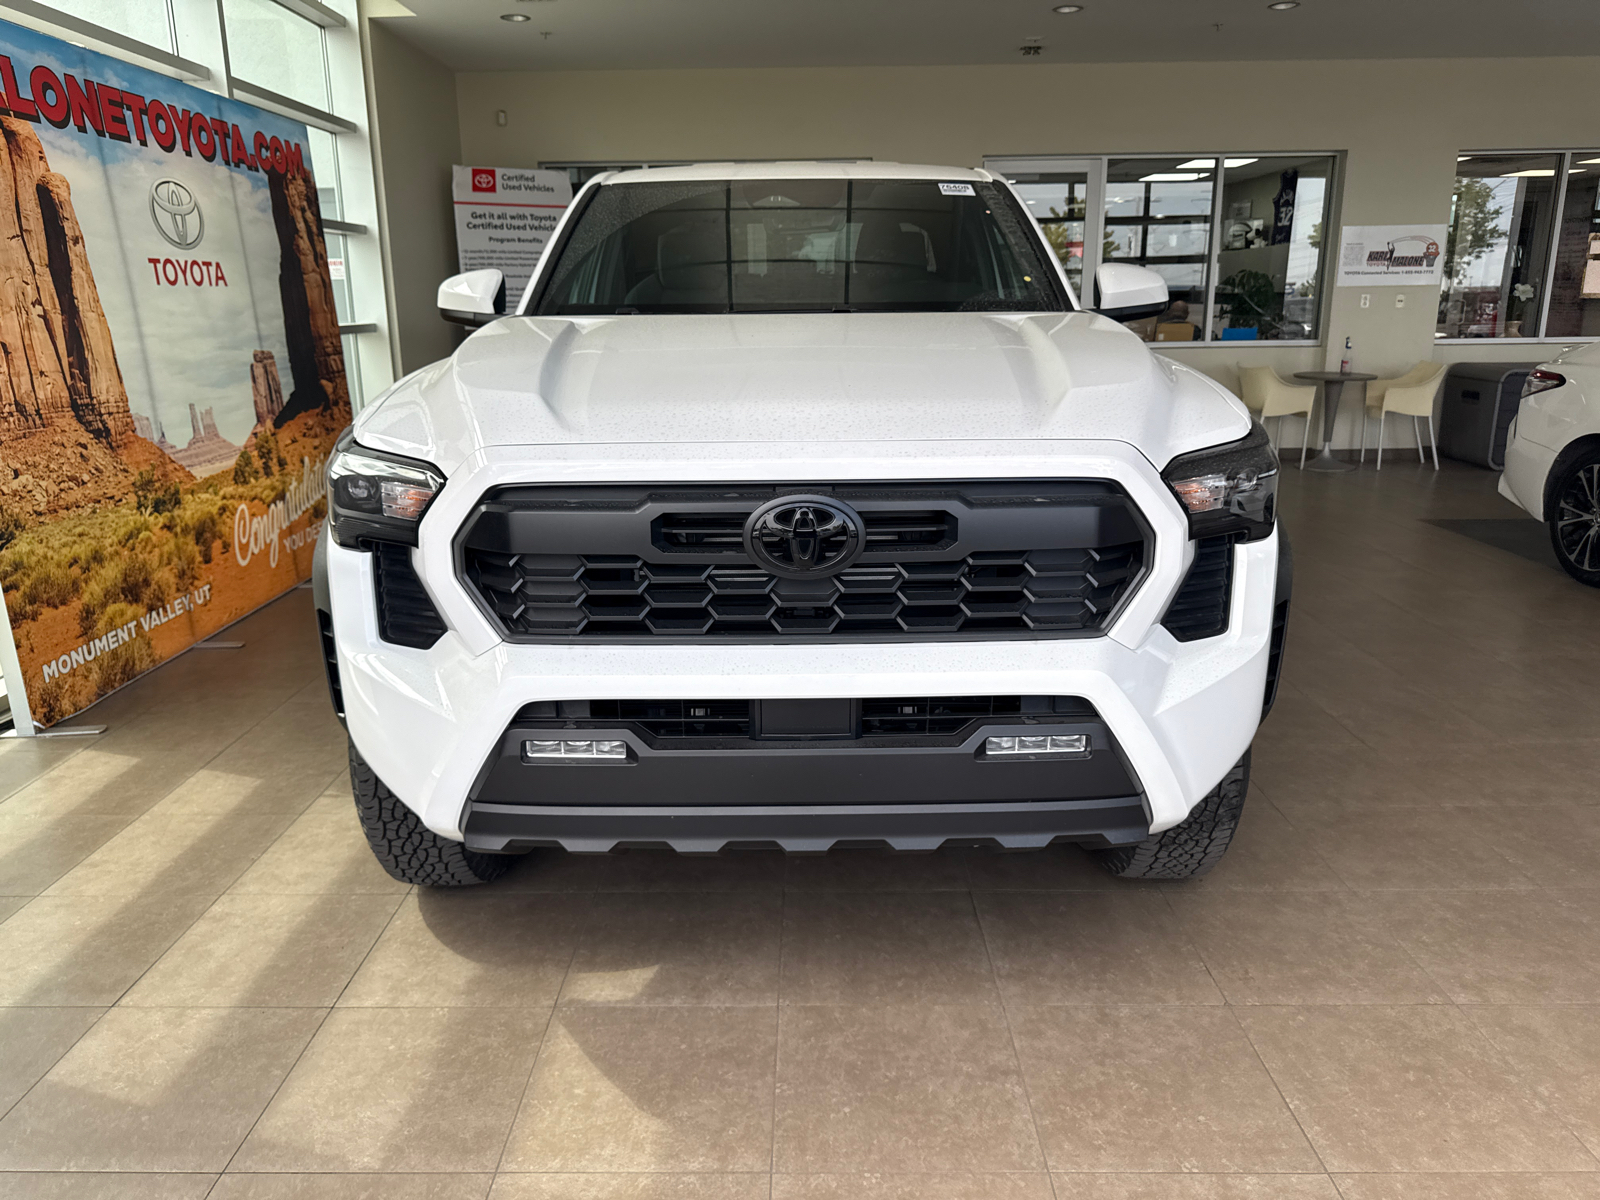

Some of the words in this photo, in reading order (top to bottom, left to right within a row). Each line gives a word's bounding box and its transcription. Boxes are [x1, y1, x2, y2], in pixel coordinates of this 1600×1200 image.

[0, 54, 306, 179] LONETOYOTA.COM
[501, 173, 536, 182] Certified
[523, 184, 555, 193] Vehicles
[471, 211, 487, 220] Get
[488, 212, 495, 220] it
[497, 212, 508, 221] all
[509, 212, 528, 222] with
[529, 213, 557, 223] Toyota
[1277, 206, 1293, 226] 32
[466, 221, 504, 231] Certified
[505, 223, 527, 231] Used
[488, 236, 517, 244] Program
[1366, 251, 1388, 261] KARL
[1391, 255, 1425, 267] MALONE
[147, 257, 228, 288] TOYOTA
[234, 452, 327, 568] Congratulati
[283, 526, 305, 553] YOU
[41, 620, 138, 683] MONUMENT
[139, 594, 195, 633] VALLEY,
[194, 584, 212, 604] UT
